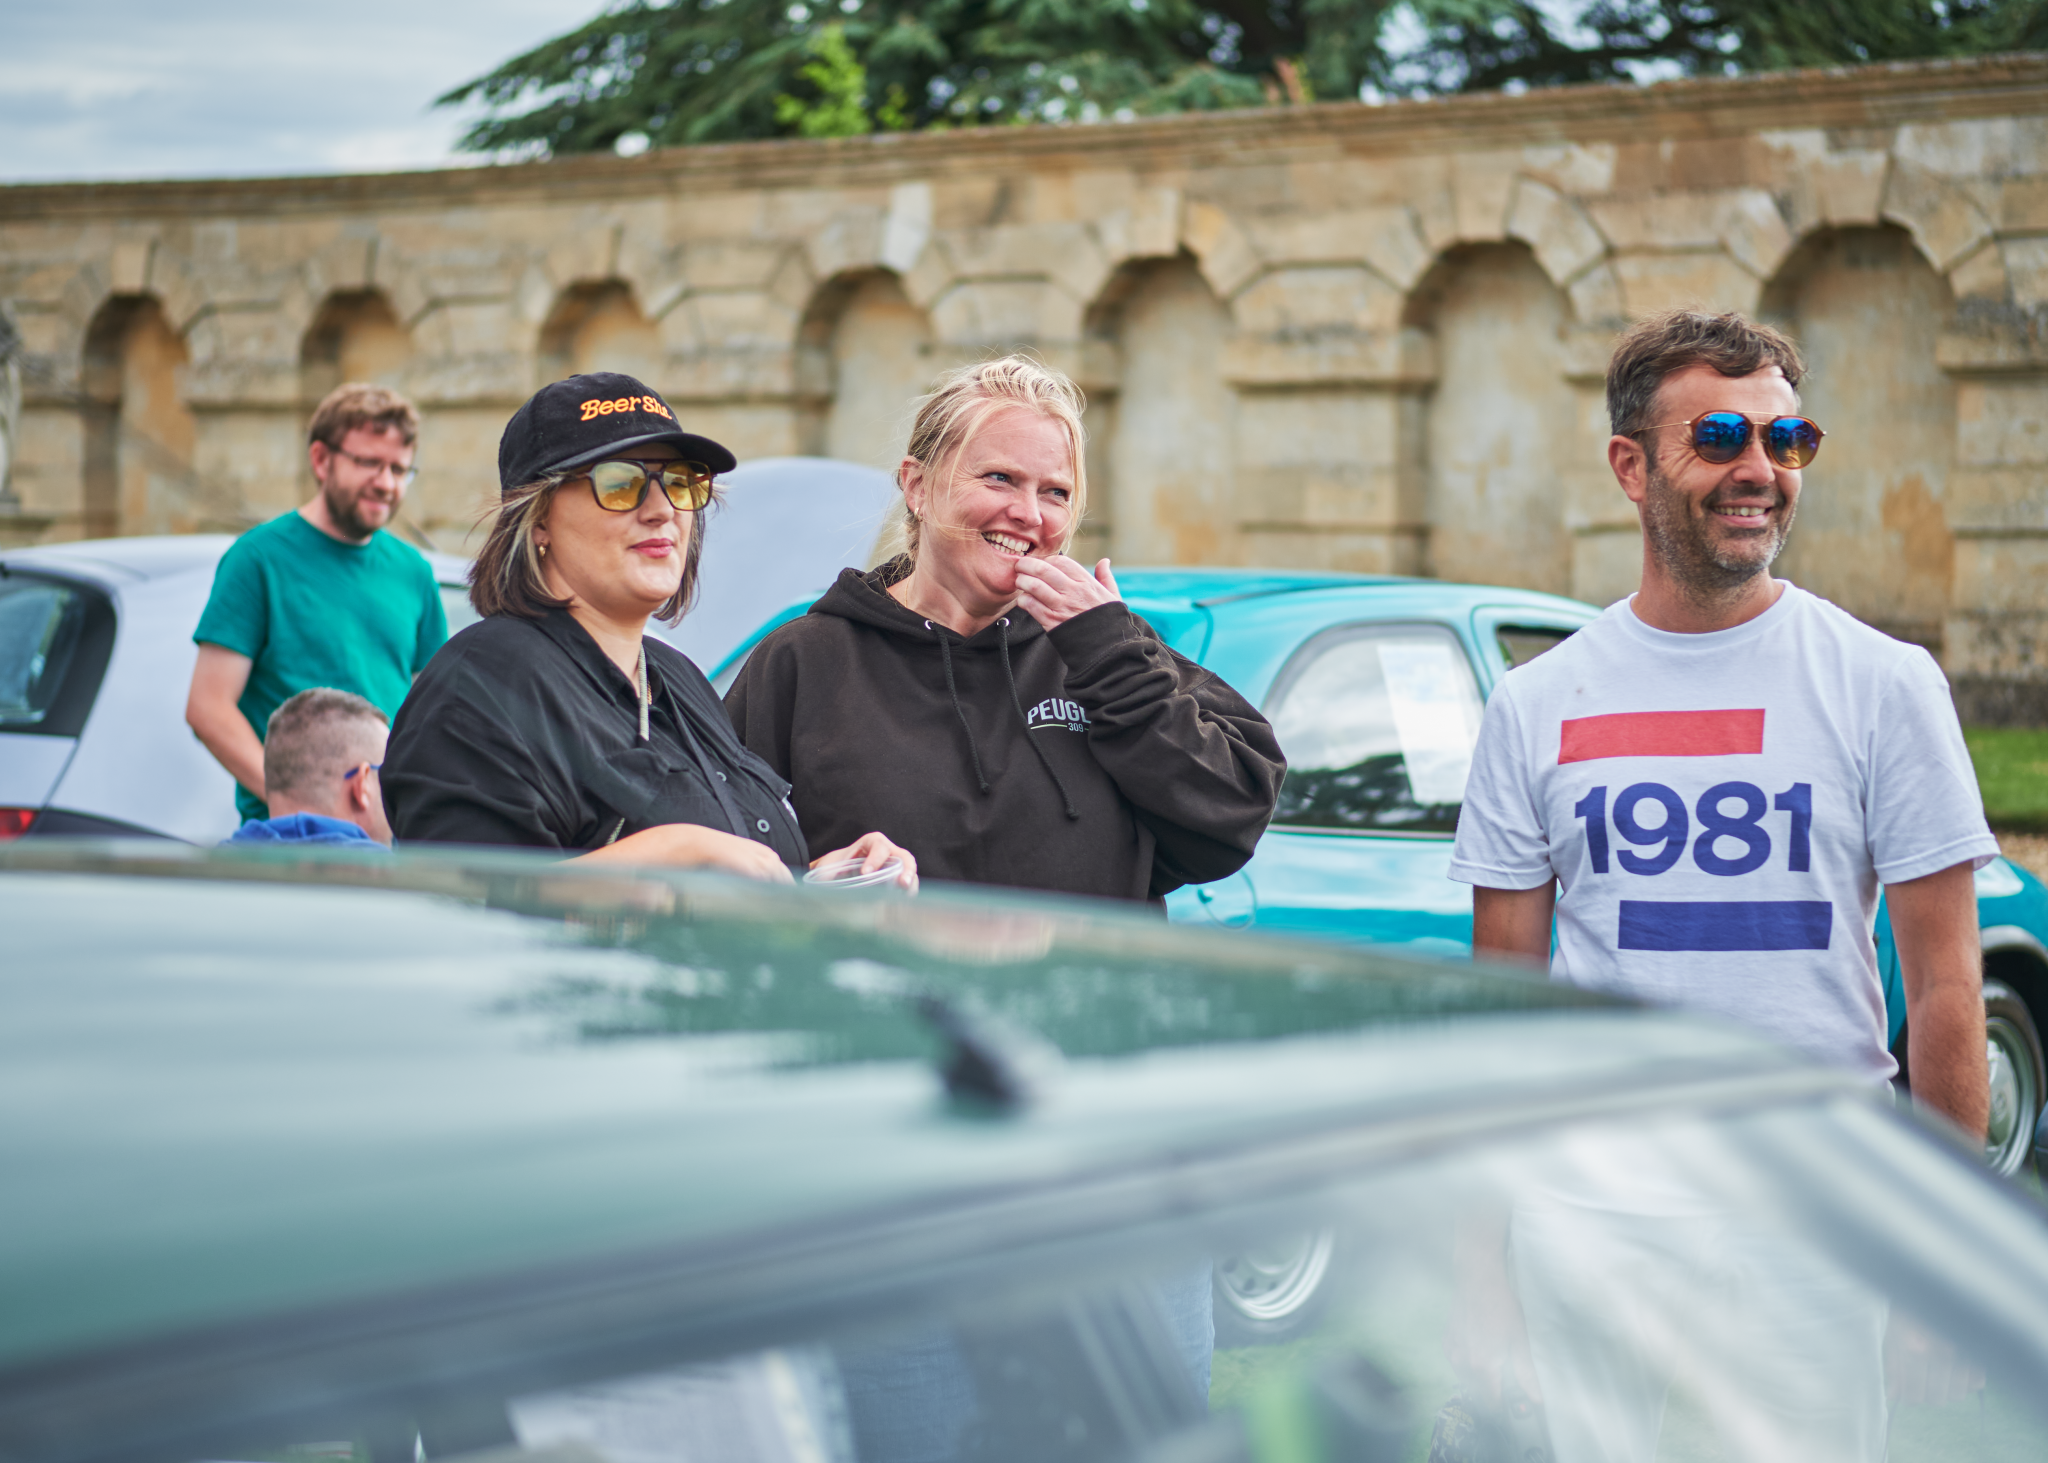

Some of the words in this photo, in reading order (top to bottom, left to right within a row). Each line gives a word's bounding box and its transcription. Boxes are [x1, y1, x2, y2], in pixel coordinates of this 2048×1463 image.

[580, 396, 641, 421] Beer
[1067, 722, 1084, 733] 309
[1575, 781, 1812, 877] 1981
